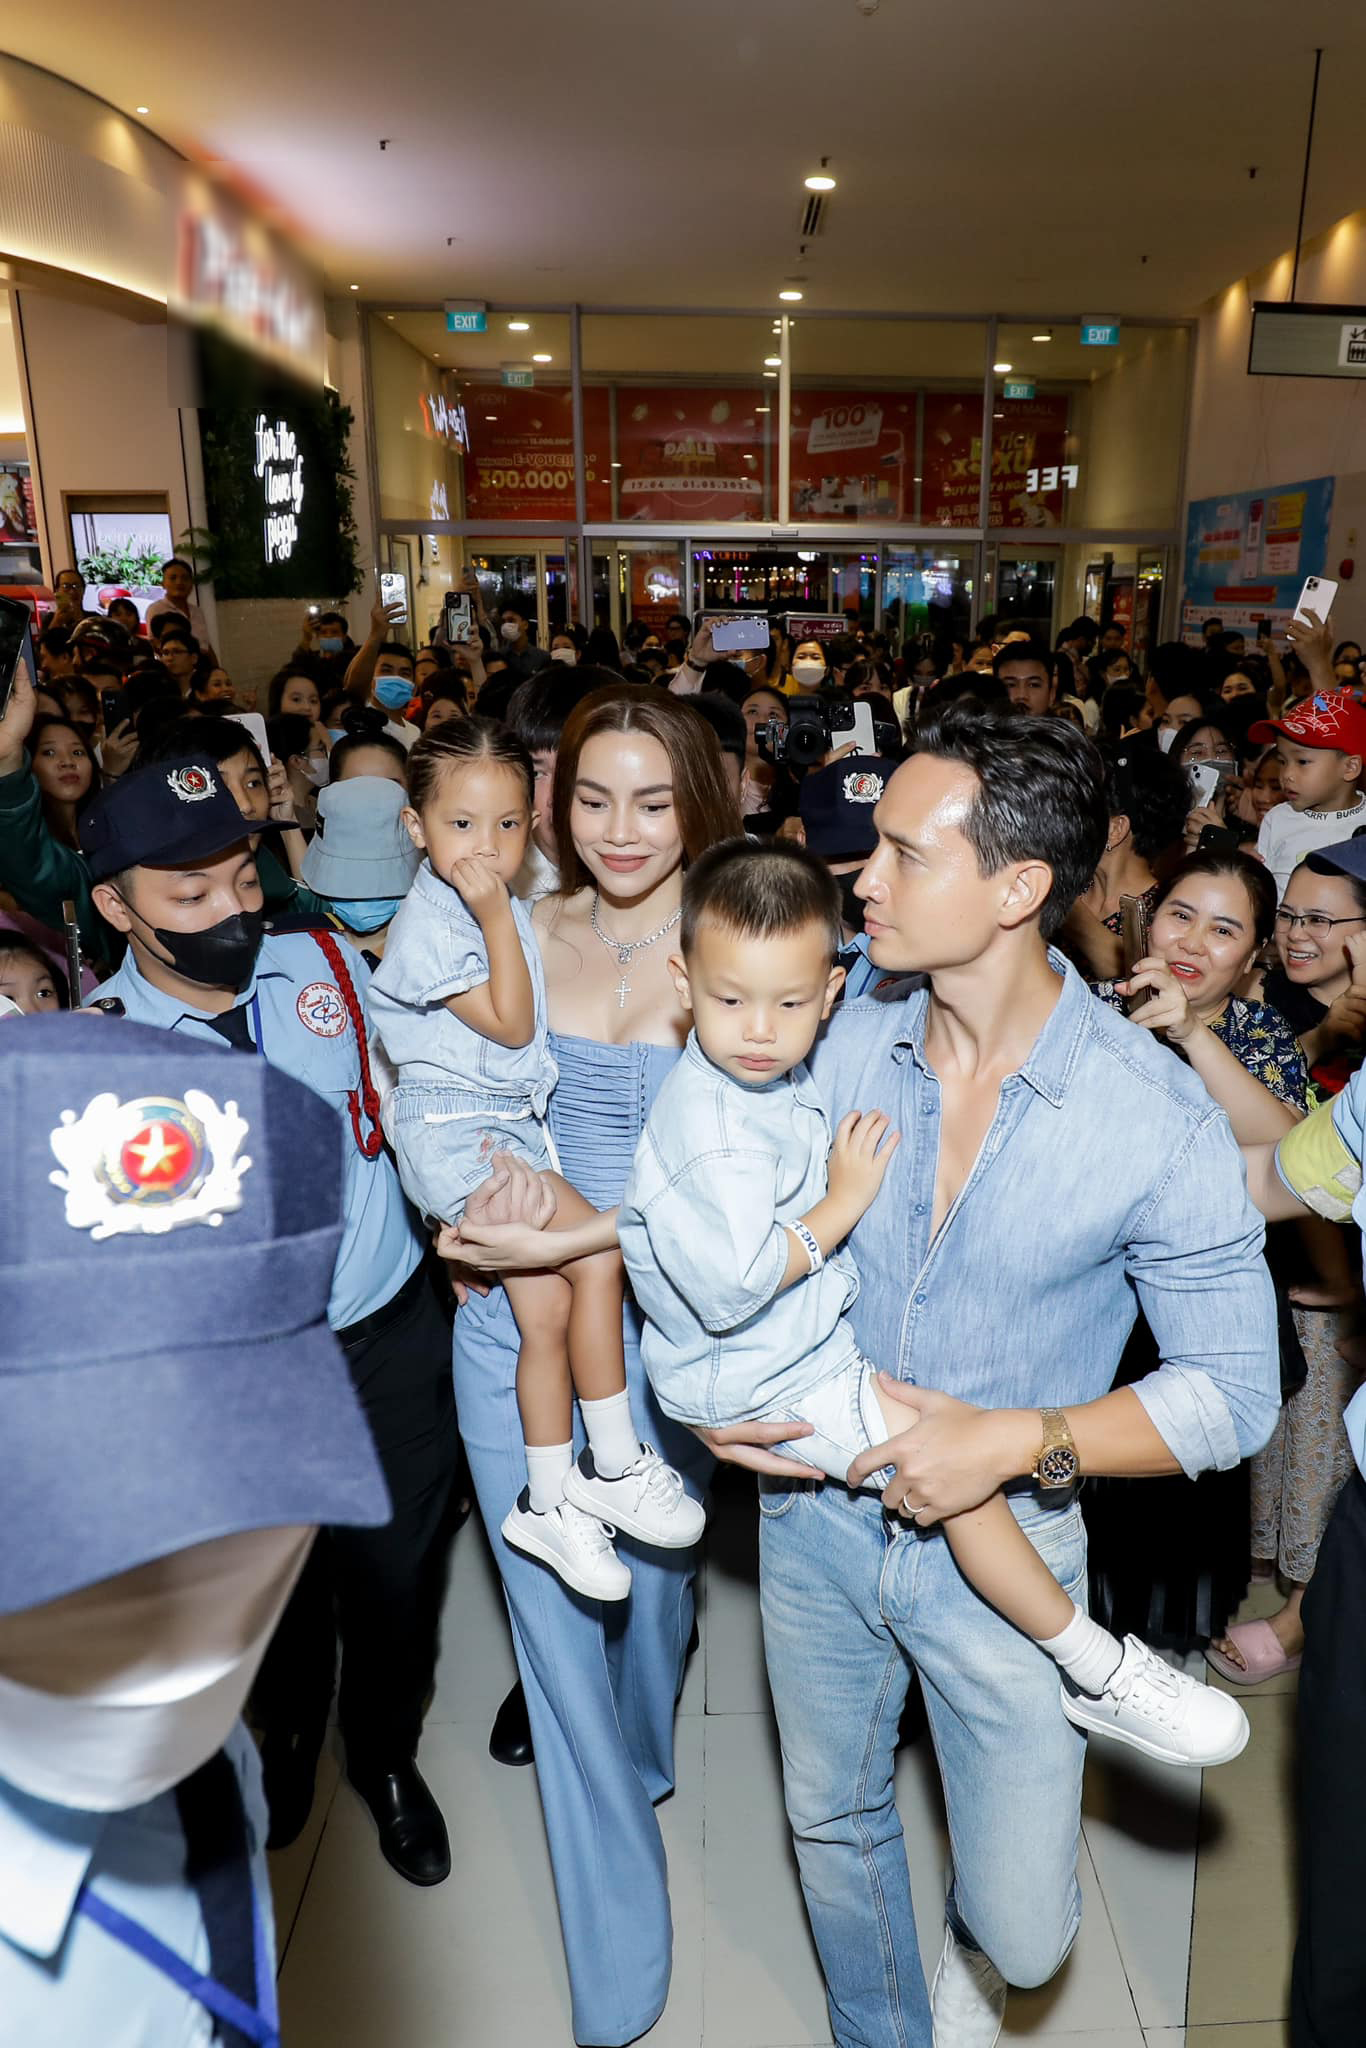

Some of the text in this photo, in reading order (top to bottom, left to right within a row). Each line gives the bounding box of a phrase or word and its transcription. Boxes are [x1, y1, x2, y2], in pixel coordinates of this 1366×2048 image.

[454, 315, 478, 329] EXIT
[1088, 328, 1112, 342] EXIT
[507, 373, 526, 384] EXIT
[1010, 385, 1028, 397] EXIT
[479, 469, 595, 489] 300.000 VD
